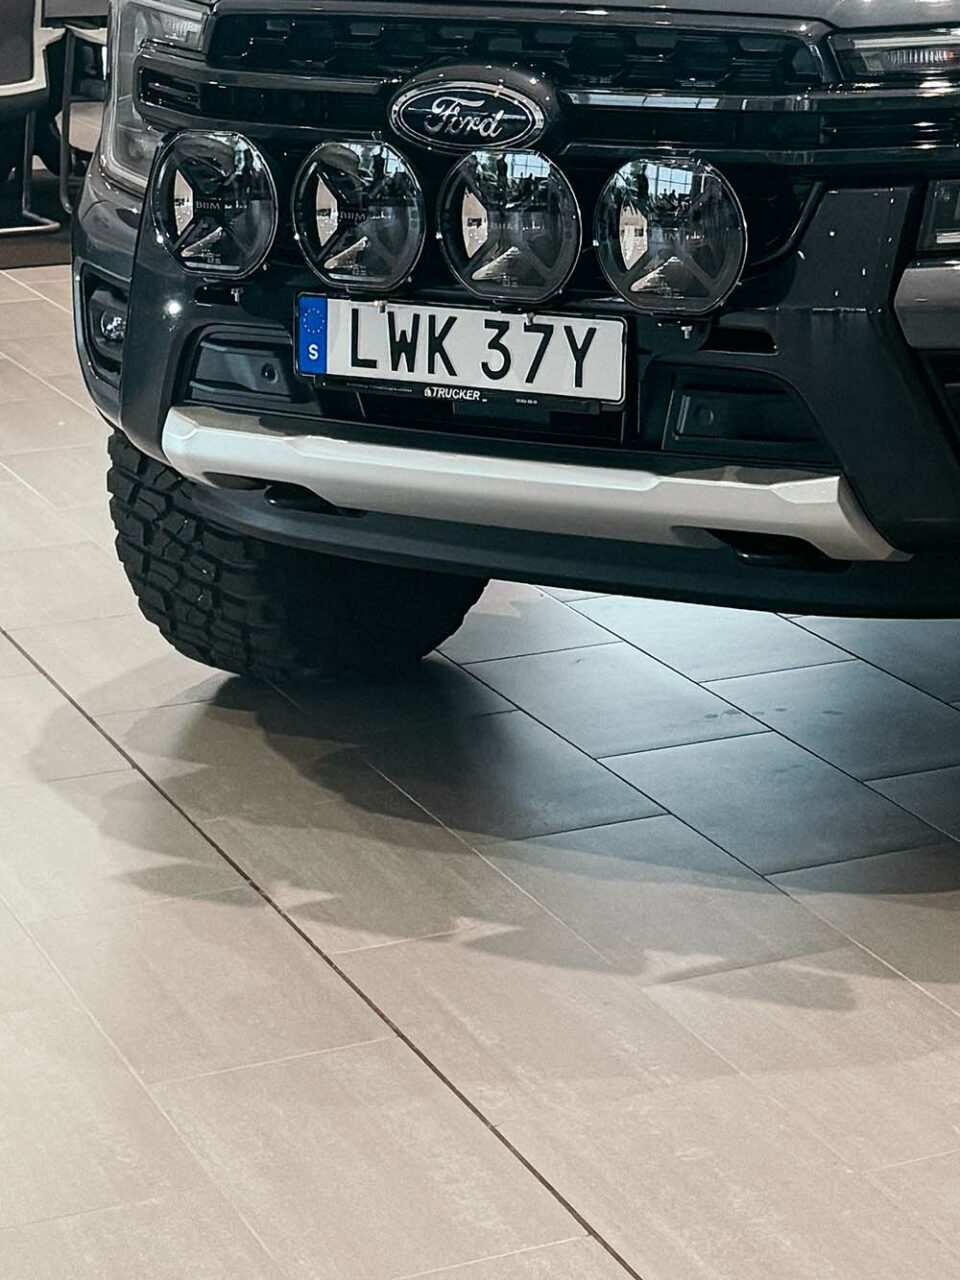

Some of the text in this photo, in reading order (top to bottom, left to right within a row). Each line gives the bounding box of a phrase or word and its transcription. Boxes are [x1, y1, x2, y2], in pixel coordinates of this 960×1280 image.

[423, 96, 505, 138] Ford
[308, 344, 319, 360] S
[351, 307, 597, 388] LWK 37Y
[432, 386, 481, 401] TRUCKER
